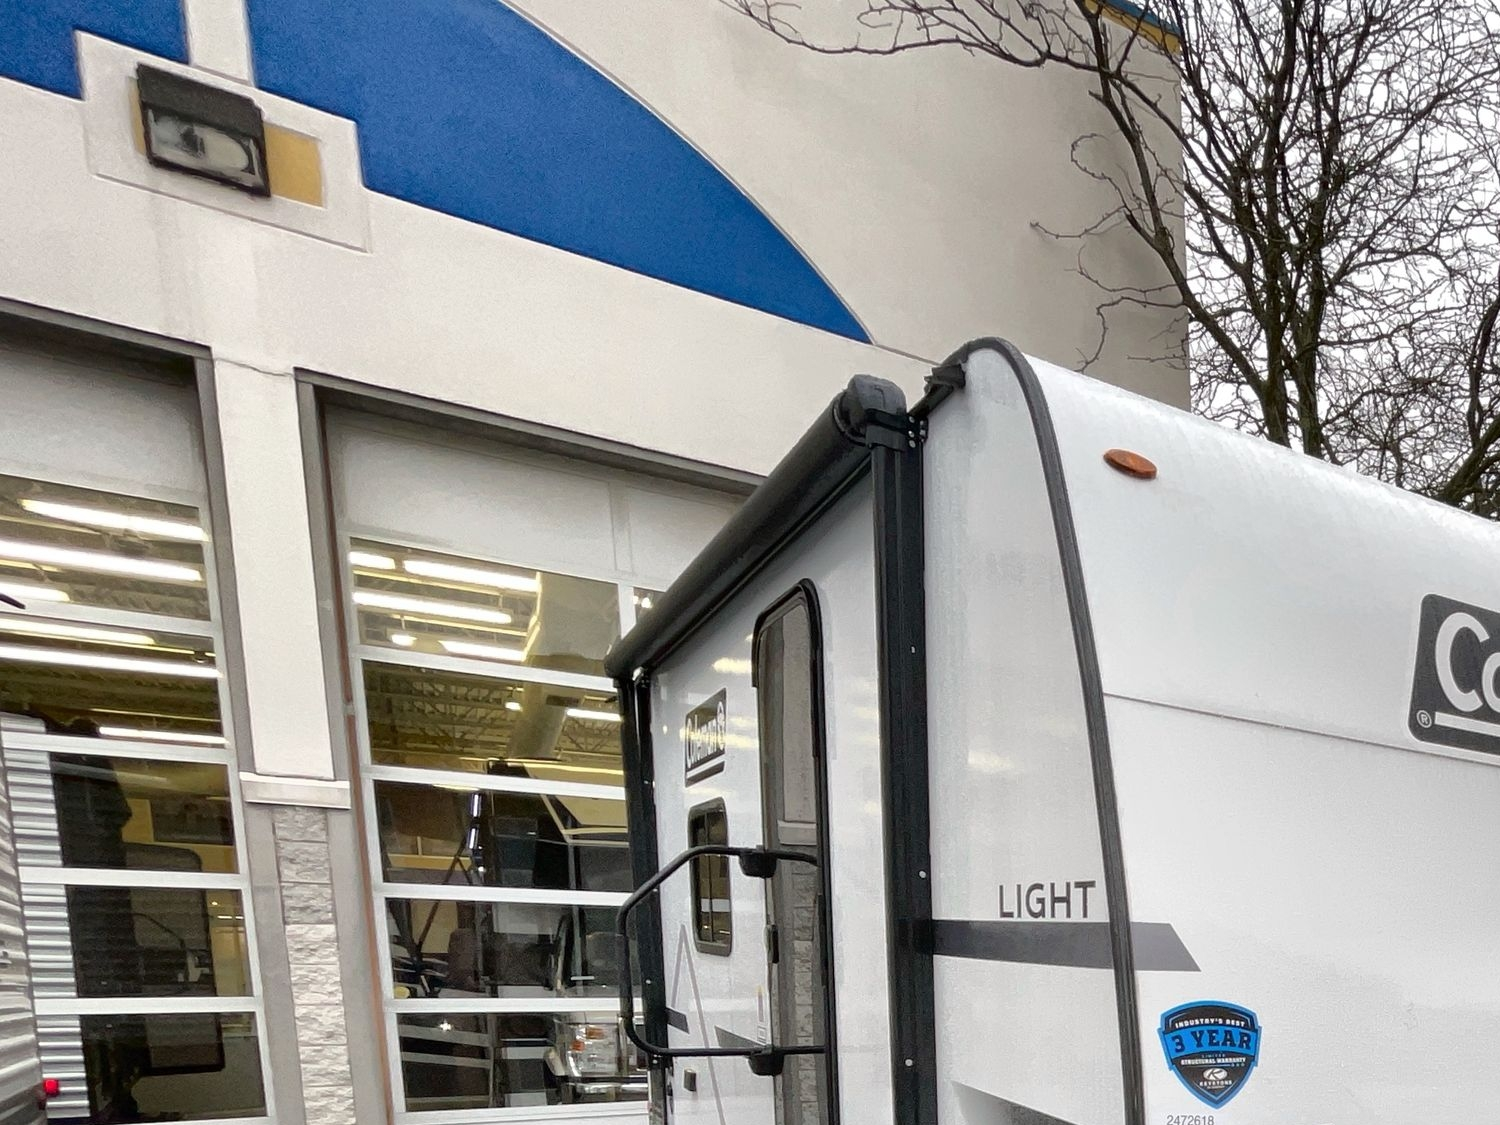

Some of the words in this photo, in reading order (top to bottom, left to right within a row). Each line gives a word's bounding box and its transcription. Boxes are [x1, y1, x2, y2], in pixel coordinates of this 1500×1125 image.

[999, 880, 1096, 918] LIGHT
[1175, 1018, 1223, 1028] INDUSTRY'S
[1225, 1019, 1246, 1028] BEST
[1171, 1034, 1186, 1053] 3
[1190, 1029, 1252, 1049] YEAR
